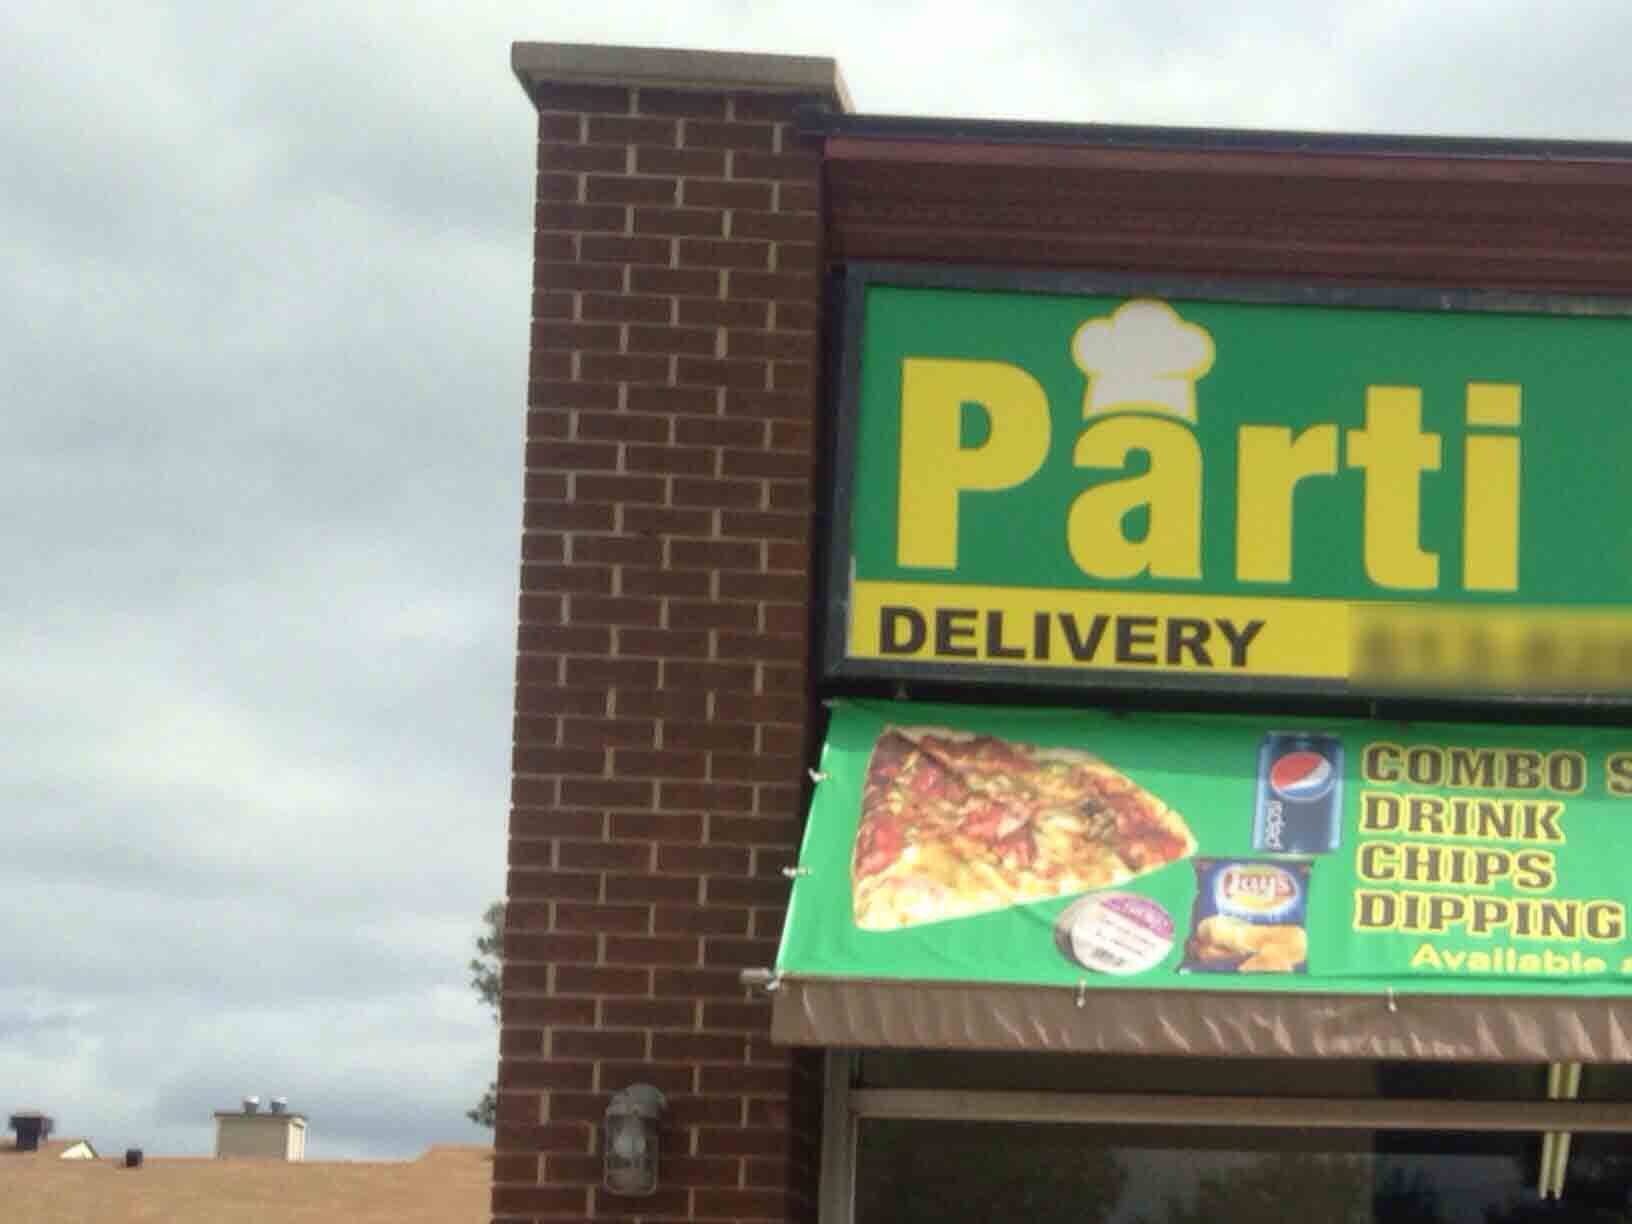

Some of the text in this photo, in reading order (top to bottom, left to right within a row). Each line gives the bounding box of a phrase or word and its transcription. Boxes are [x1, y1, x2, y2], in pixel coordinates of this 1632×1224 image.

[897, 357, 1522, 593] Parti
[879, 605, 1266, 668] DELIVERY
[1362, 744, 1586, 793] COMBO
[1359, 793, 1566, 843] DRINK
[1357, 841, 1556, 891] CHIPS
[1354, 891, 1624, 942] DIPPING
[1409, 943, 1606, 976] Available
